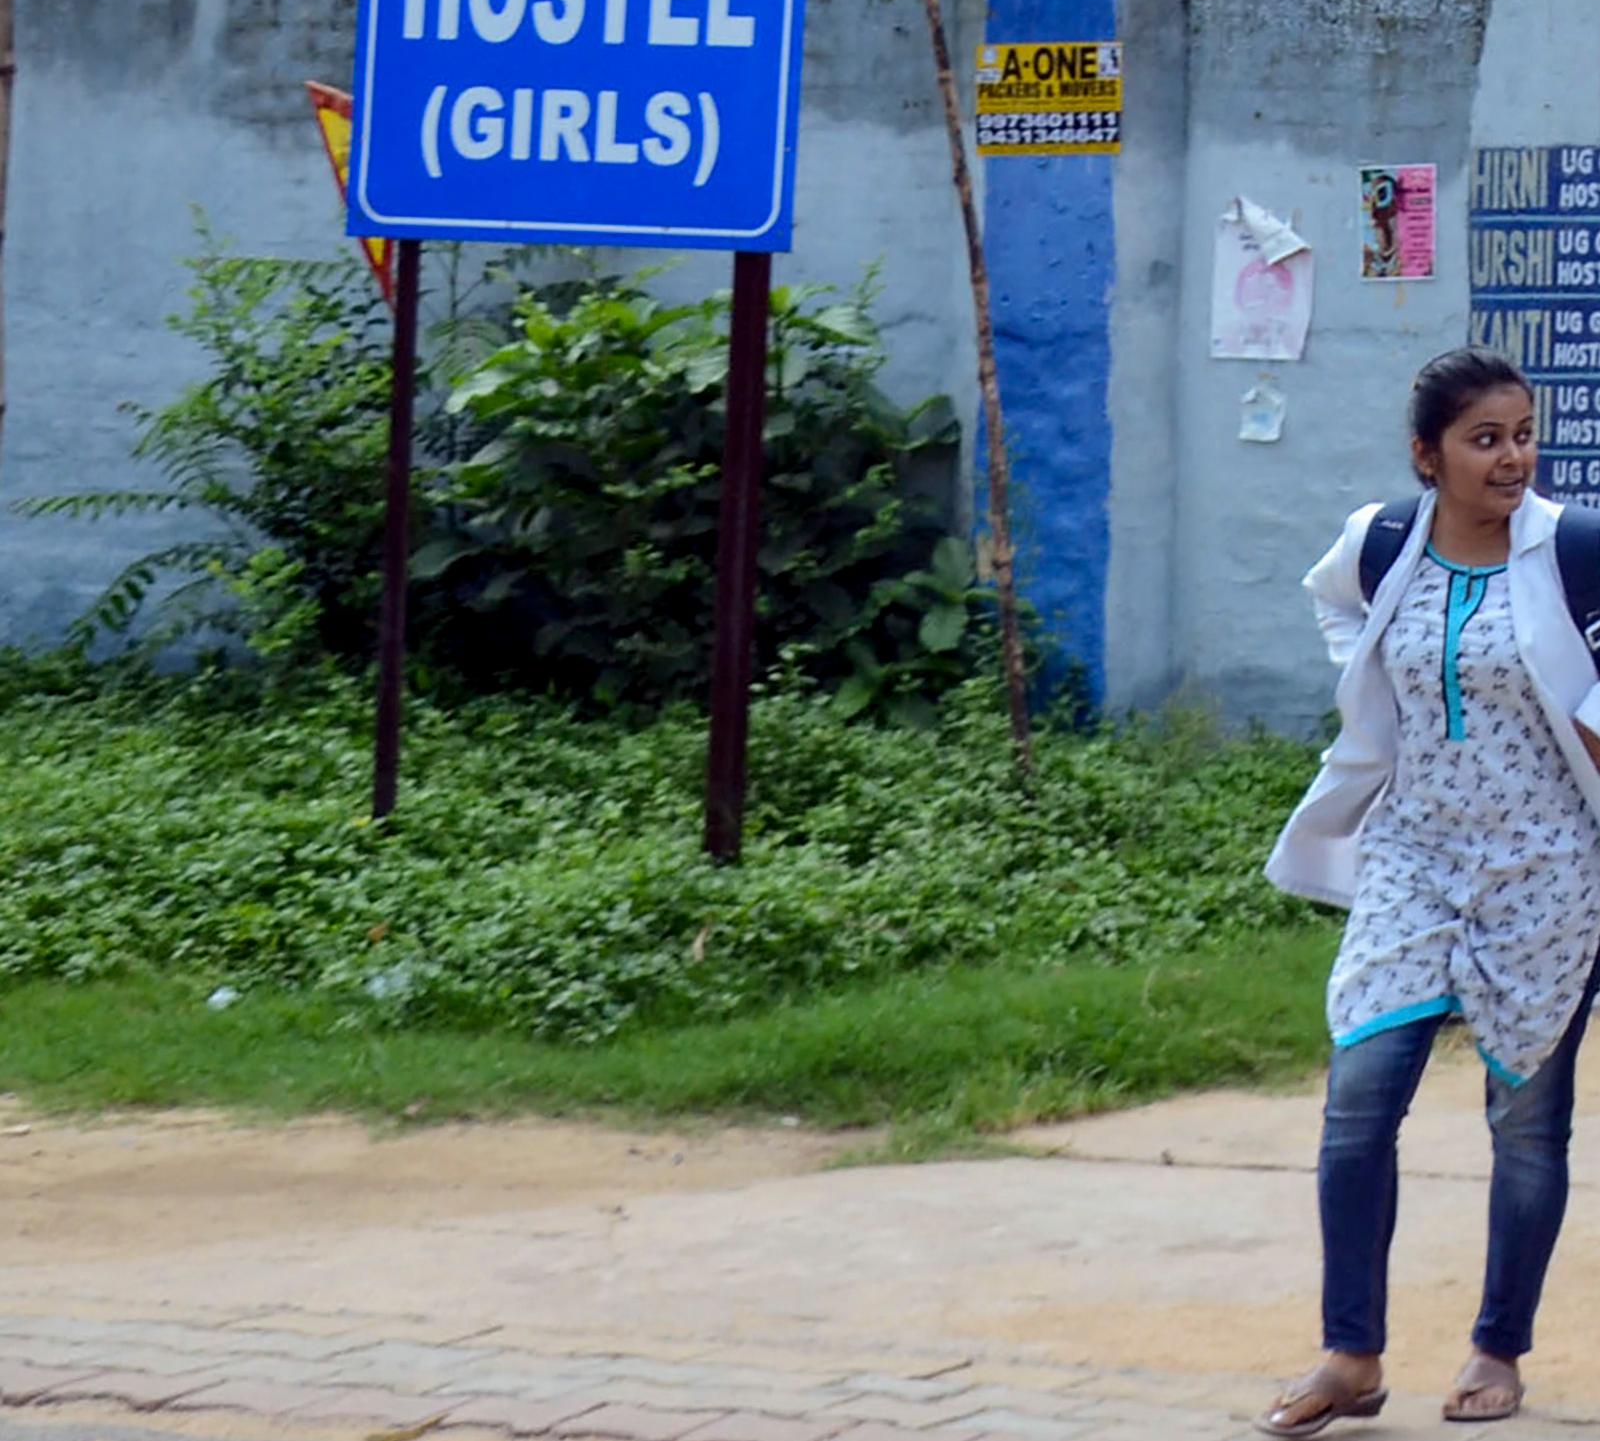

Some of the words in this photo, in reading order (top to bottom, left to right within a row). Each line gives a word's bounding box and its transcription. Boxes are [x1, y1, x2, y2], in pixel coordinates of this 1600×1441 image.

[421, 85, 720, 187] (GIRLS)
[1562, 148, 1594, 174] UG
[1471, 146, 1547, 210] HIRNI
[1558, 230, 1590, 254] UG
[1472, 229, 1553, 287] URSHI
[1555, 310, 1583, 334] UG
[1557, 385, 1589, 413] UG
[1553, 461, 1582, 486] UG
